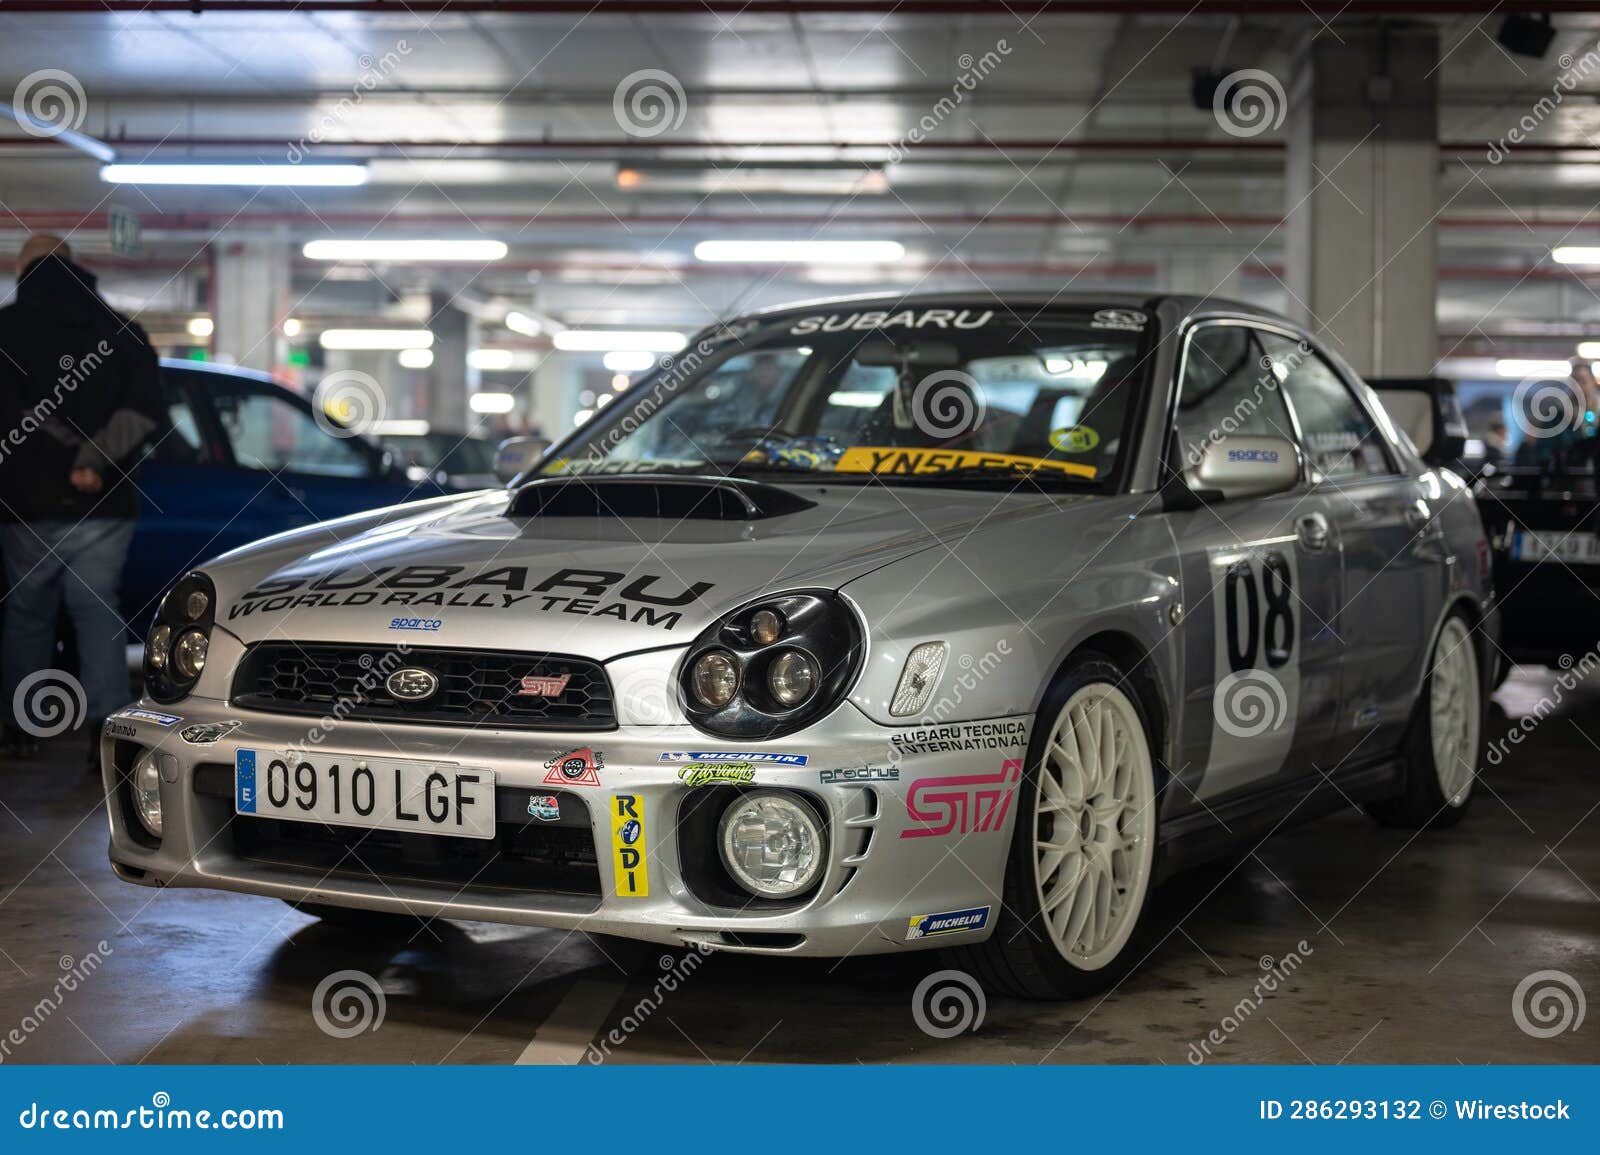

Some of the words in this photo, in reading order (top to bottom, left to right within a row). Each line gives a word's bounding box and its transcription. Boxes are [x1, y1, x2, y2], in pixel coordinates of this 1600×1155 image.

[790, 309, 994, 335] SUBARU
[241, 565, 716, 607] SUBARU
[228, 591, 379, 620] WORLD
[382, 591, 532, 609] RALLY
[541, 596, 683, 631] TEAM
[1225, 551, 1295, 679] 08
[388, 616, 442, 631] sparco
[891, 727, 961, 745] SUBARU
[963, 722, 1026, 737] TECNICA
[897, 735, 1028, 755] INTERNATIONAL
[698, 752, 799, 763] MICHELIN
[820, 765, 899, 784] prodrive
[242, 787, 251, 801] E
[267, 759, 375, 817] 0910
[395, 769, 480, 825] LGF
[929, 914, 983, 930] MICHELIN
